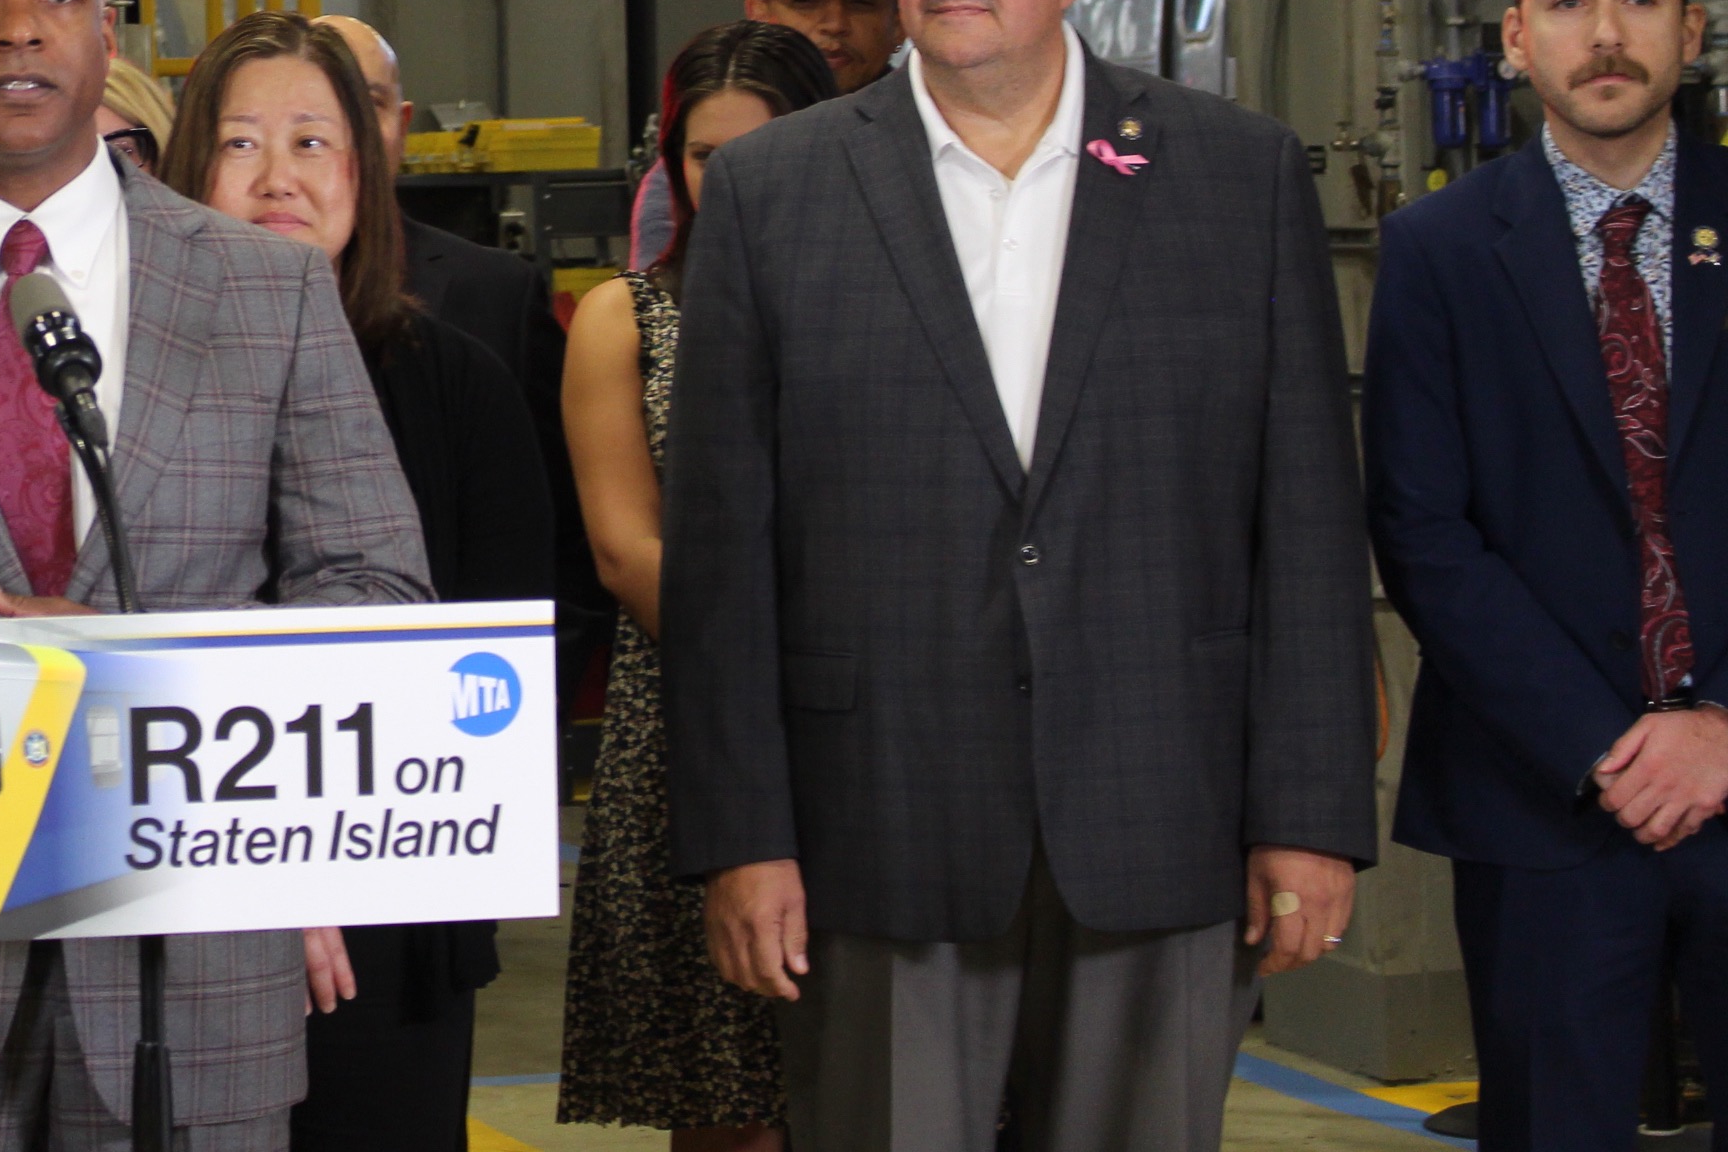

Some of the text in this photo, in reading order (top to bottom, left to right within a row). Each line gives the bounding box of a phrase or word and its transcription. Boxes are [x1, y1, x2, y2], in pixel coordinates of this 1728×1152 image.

[450, 671, 513, 722] MTA
[130, 702, 465, 806] R211 on
[125, 804, 502, 870] Staten Island
